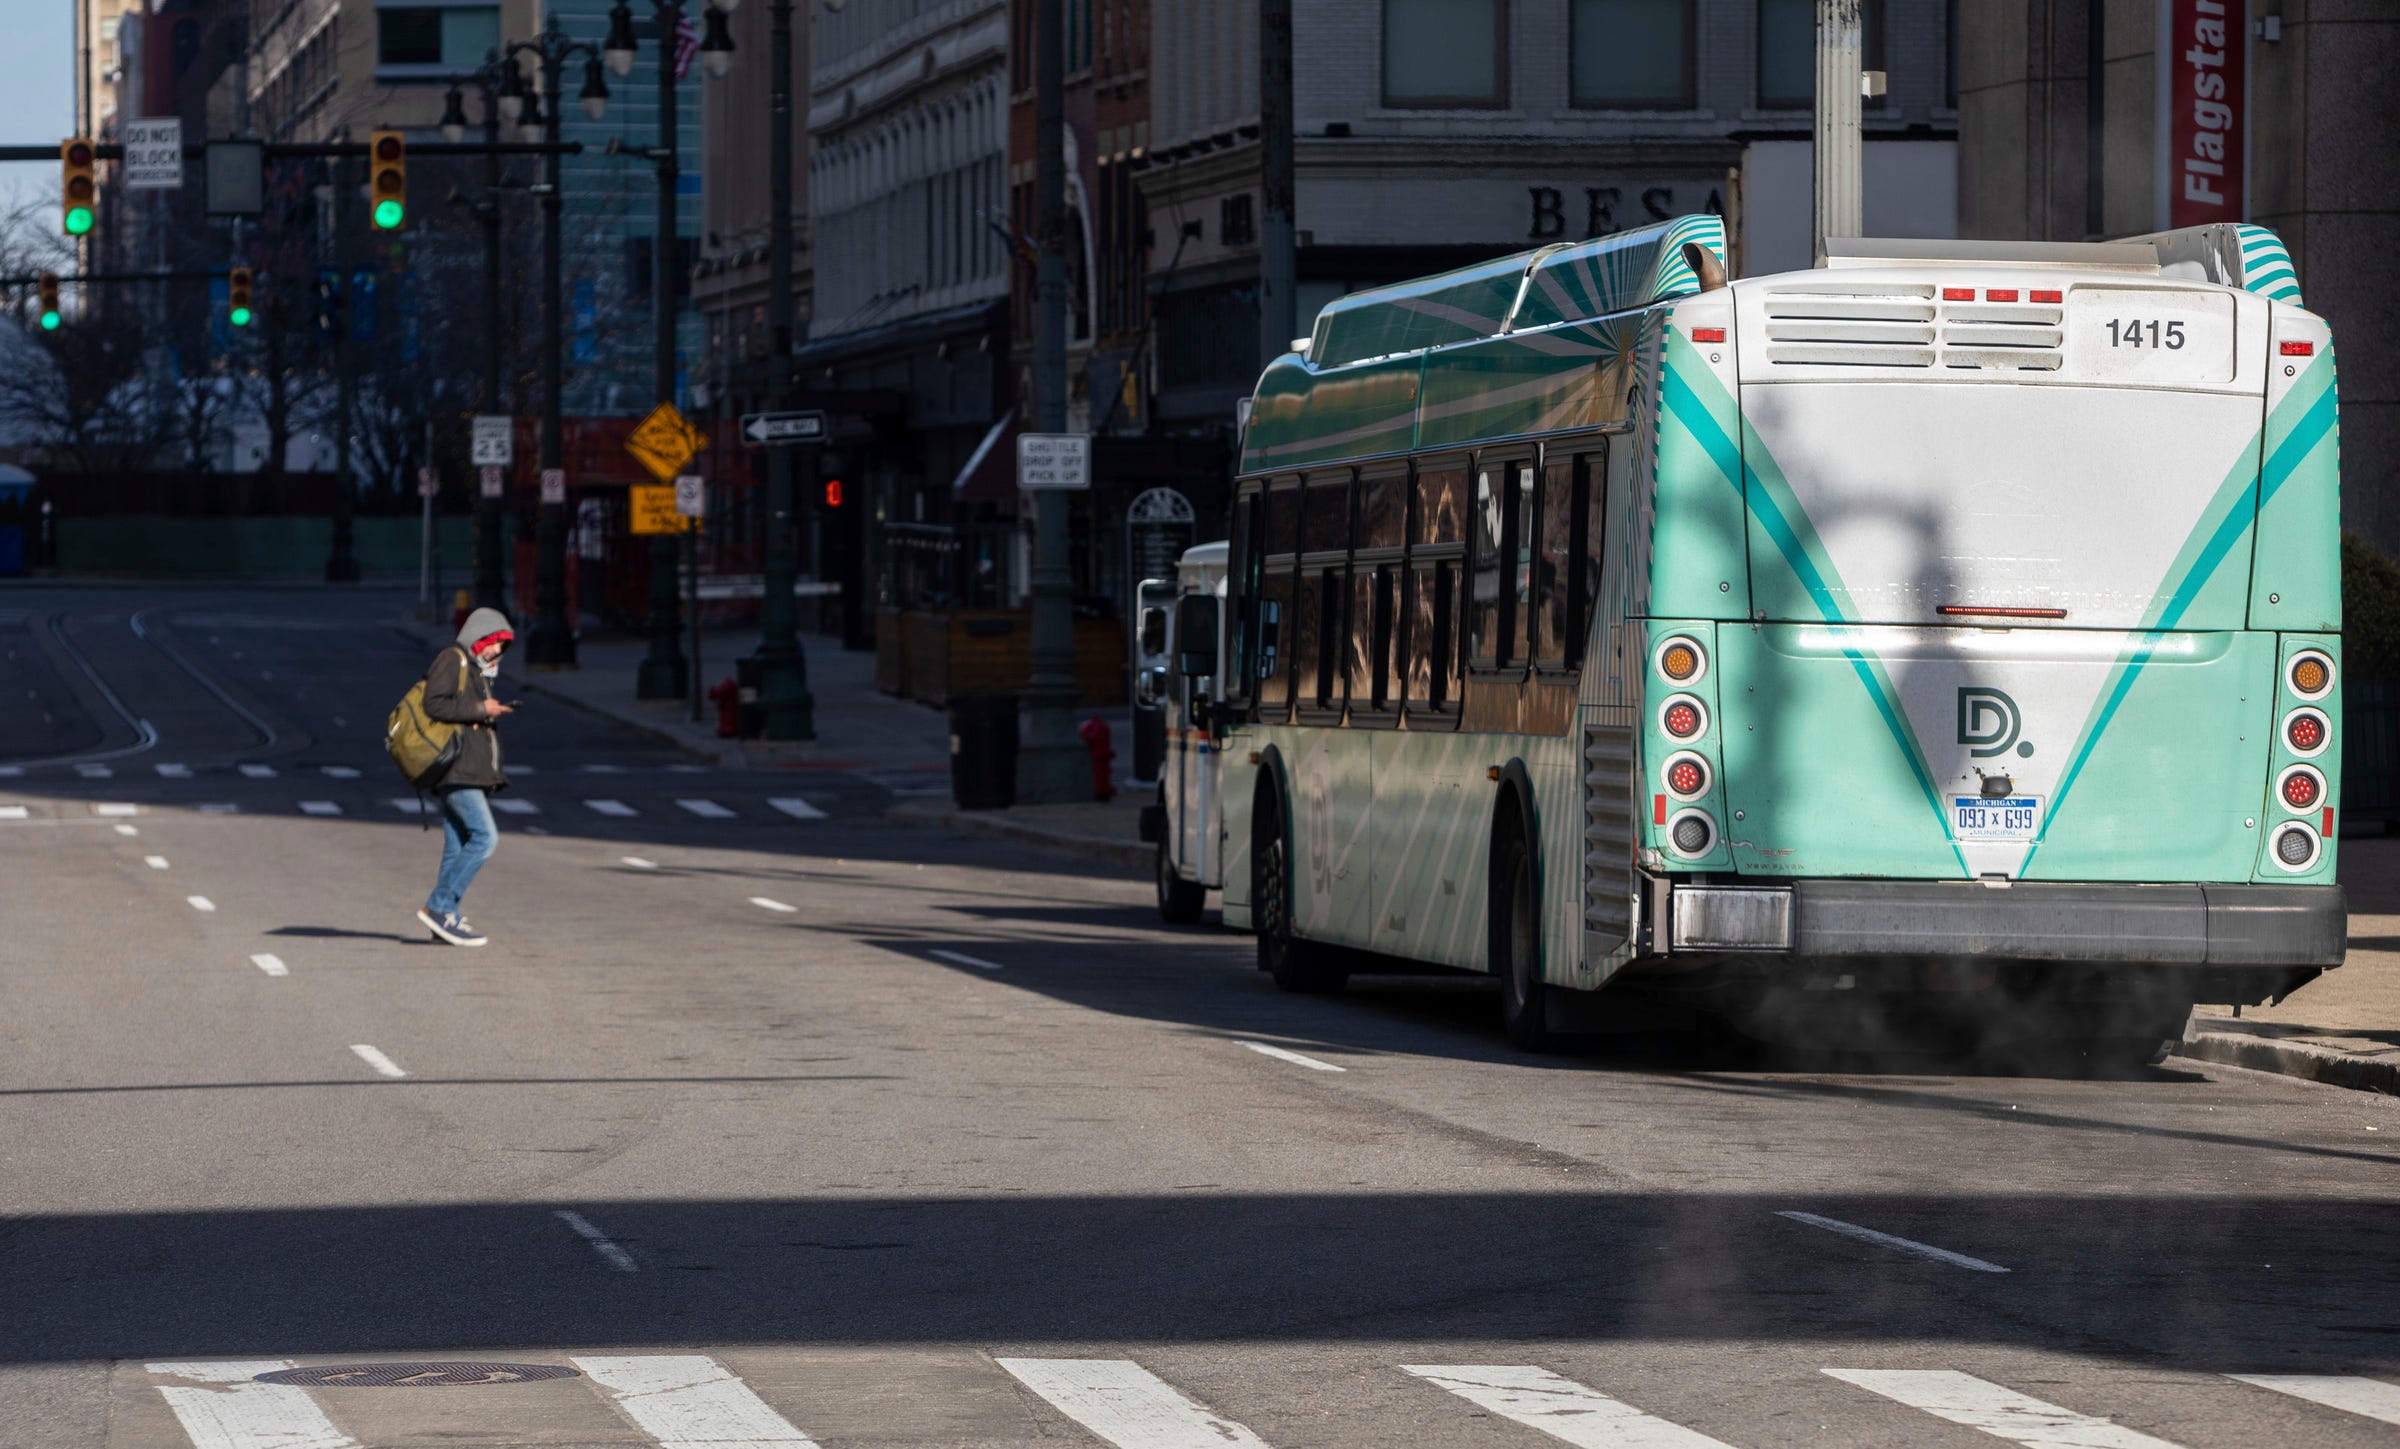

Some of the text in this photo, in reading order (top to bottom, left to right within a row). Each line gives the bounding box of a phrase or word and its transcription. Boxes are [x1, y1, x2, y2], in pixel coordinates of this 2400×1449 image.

[127, 126, 178, 144] DO NOT
[127, 149, 178, 166] BLOCK
[2106, 318, 2186, 351] 1415
[477, 440, 507, 458] 25
[1024, 455, 1082, 466] DROP OFF
[1063, 470, 1080, 481] UP
[1975, 799, 2016, 807] MICHIGAN
[1958, 808, 1986, 829] 093
[2005, 808, 2032, 829] 699
